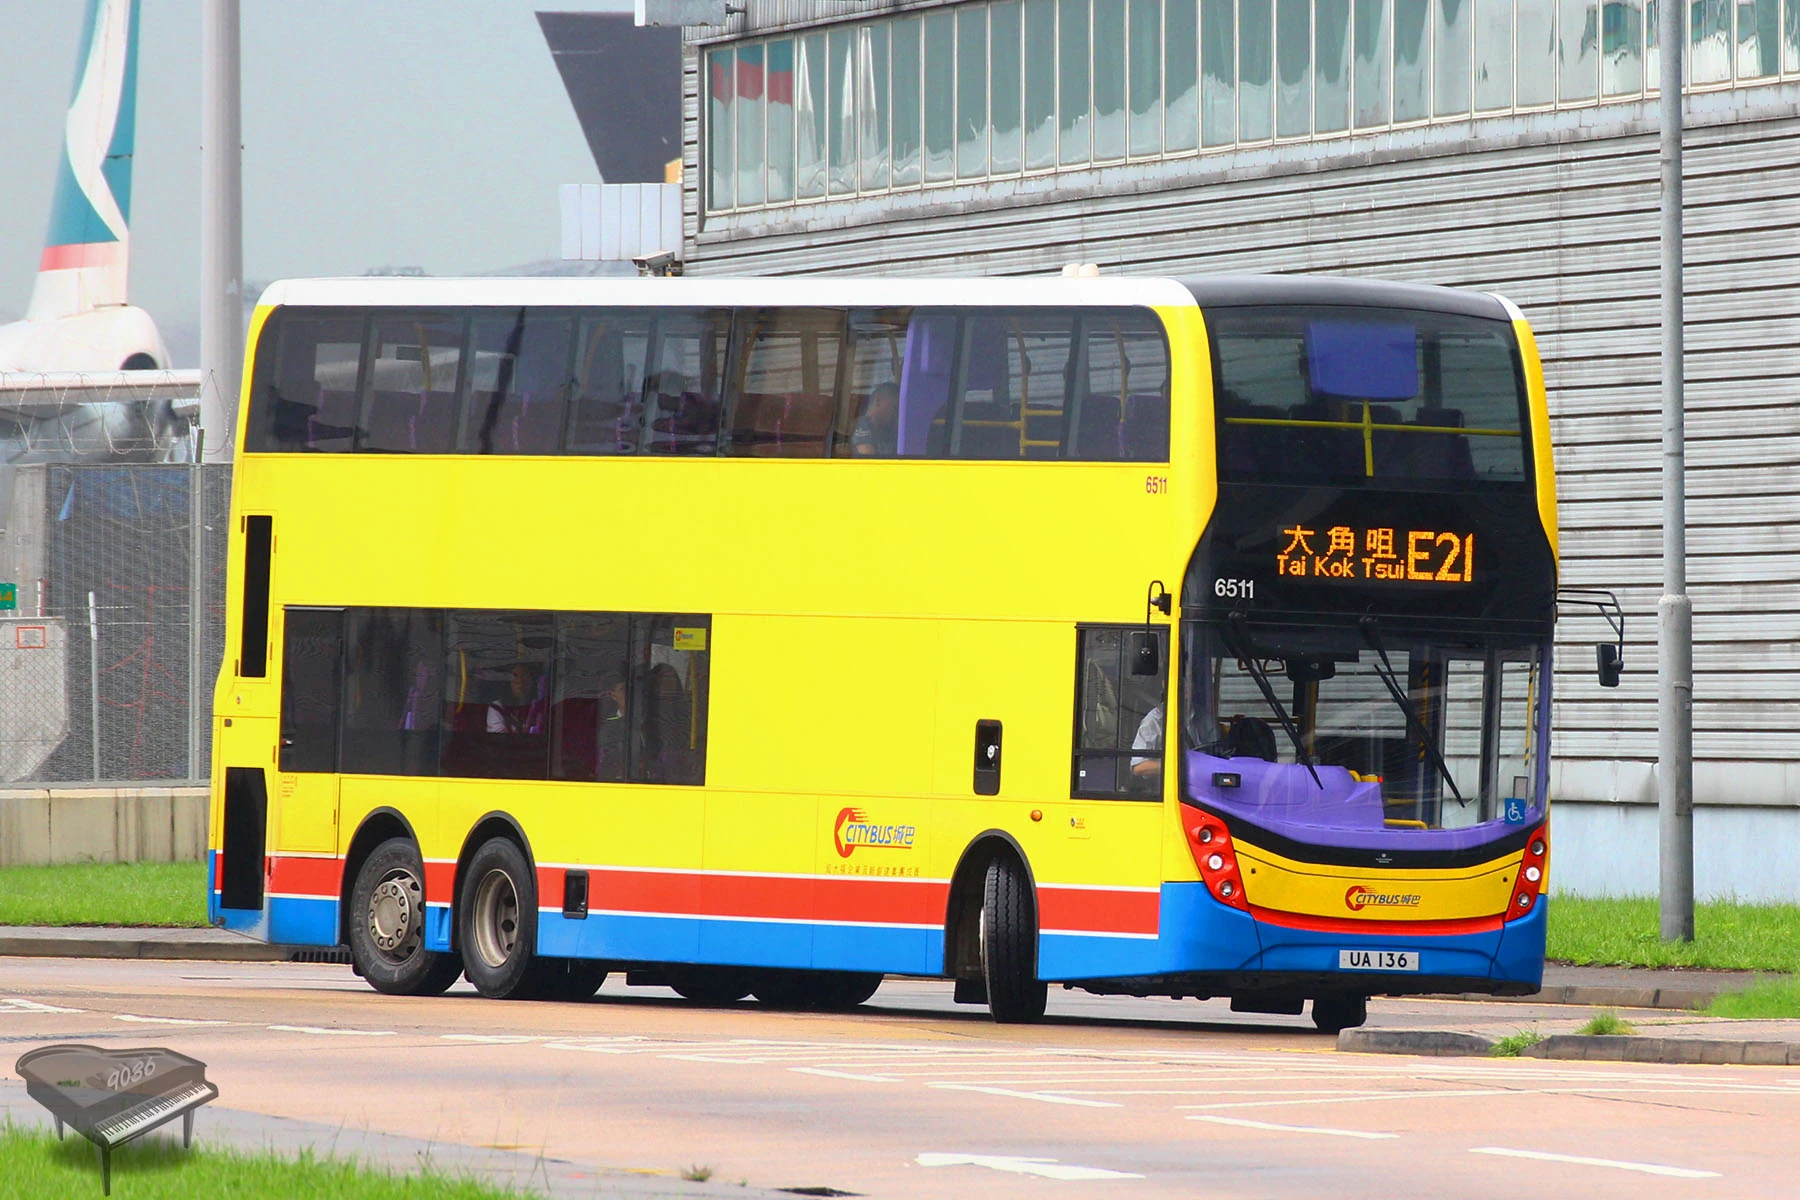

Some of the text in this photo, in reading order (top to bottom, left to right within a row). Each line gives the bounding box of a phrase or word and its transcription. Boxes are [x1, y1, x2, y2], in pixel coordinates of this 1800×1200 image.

[1146, 476, 1167, 494] 6511
[1283, 525, 1397, 559] 大角咀
[1407, 531, 1474, 582] E21
[1277, 555, 1405, 580] Tai Kok Tsui
[1214, 578, 1255, 599] 6511
[846, 824, 893, 844] CITYBUS
[1355, 894, 1400, 905] CITYBUS
[1350, 951, 1408, 968] UA 136
